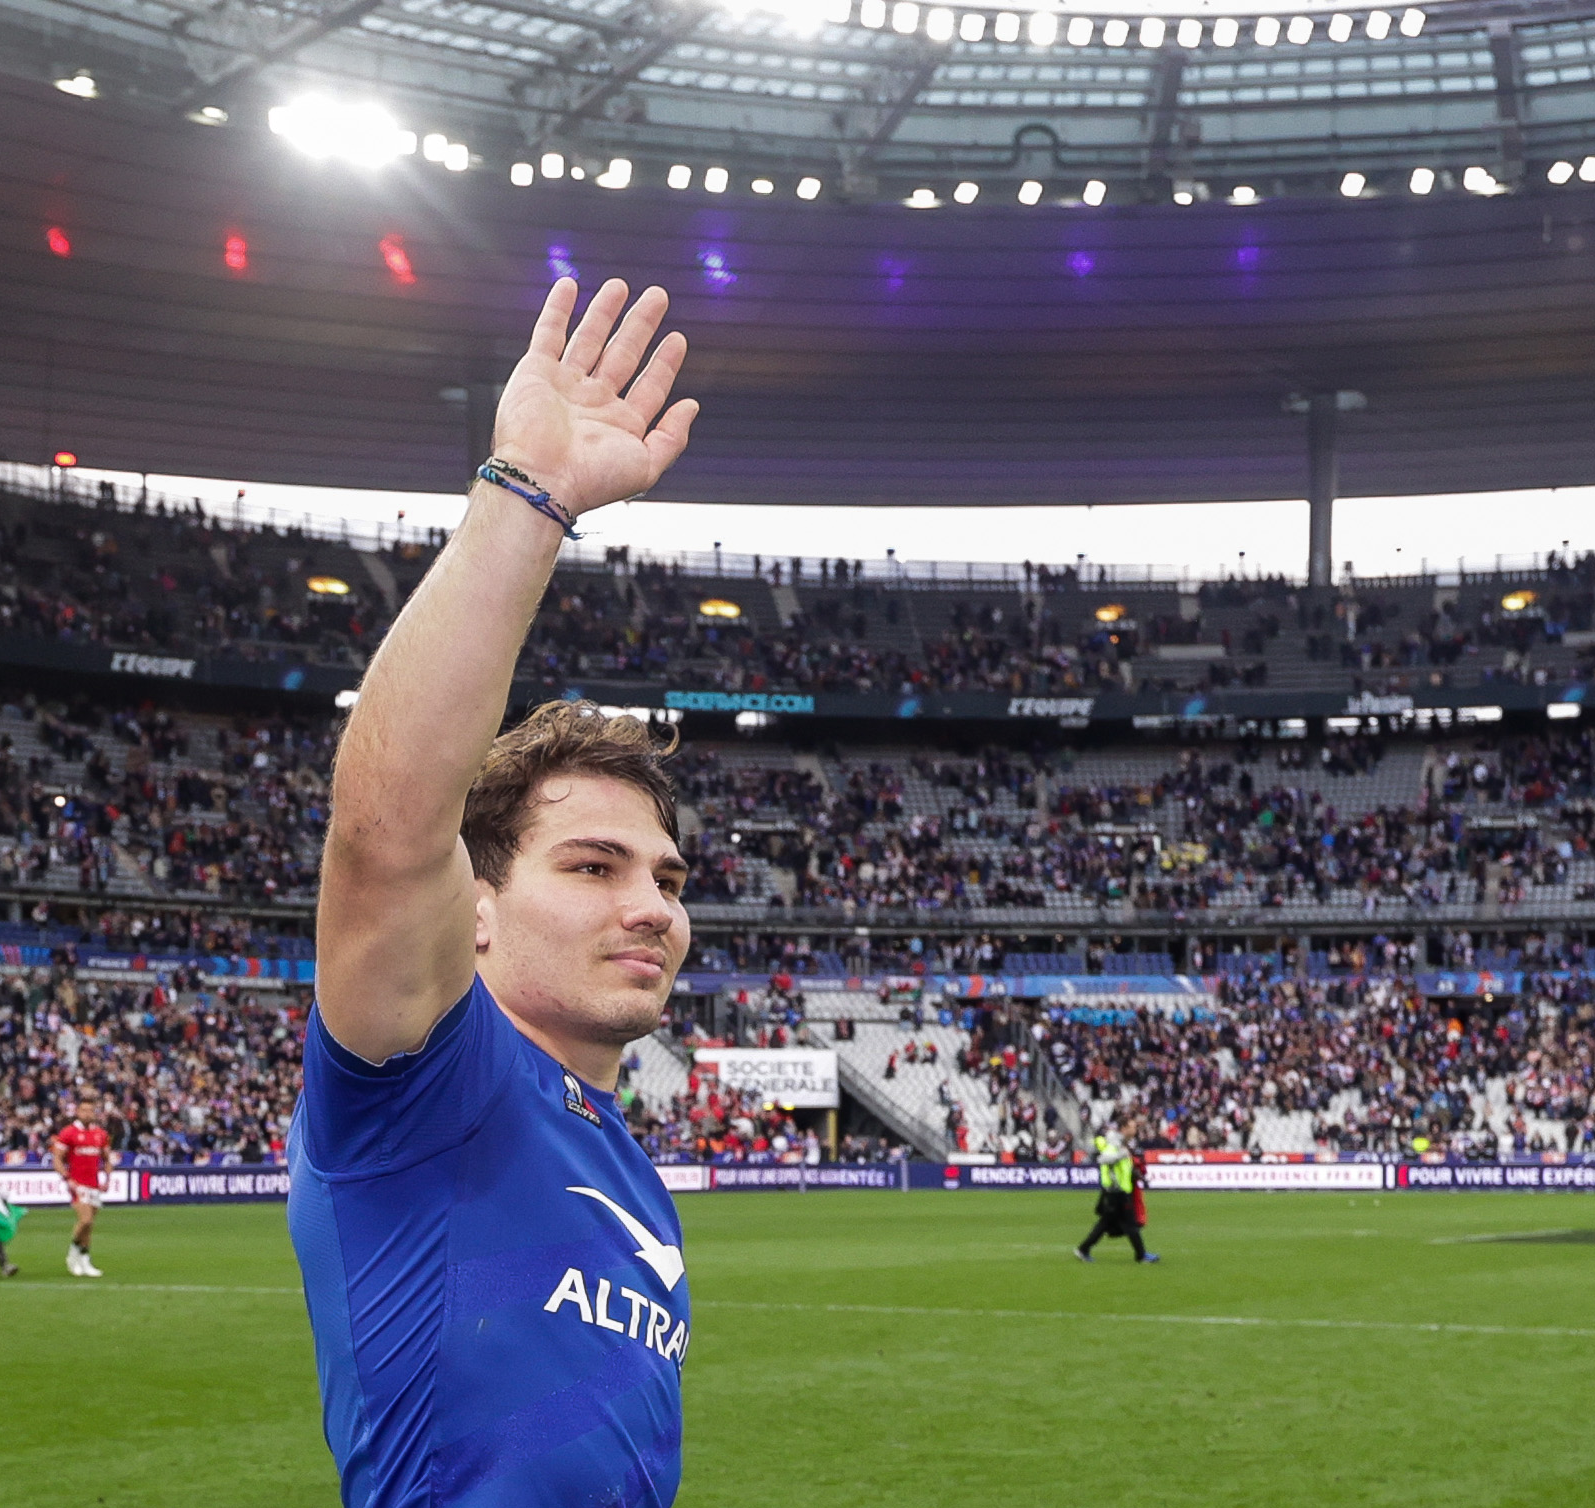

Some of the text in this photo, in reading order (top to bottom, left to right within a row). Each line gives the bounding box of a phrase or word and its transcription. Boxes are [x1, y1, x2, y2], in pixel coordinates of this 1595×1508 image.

[150, 1174, 187, 1195] POUR
[971, 1166, 1100, 1185] RENDEZ-VOUS SUR
[1408, 1167, 1452, 1185] POUR
[1455, 1167, 1504, 1186] VIVRE
[1506, 1167, 1541, 1187] UNE
[543, 1267, 690, 1364] ALTRA
